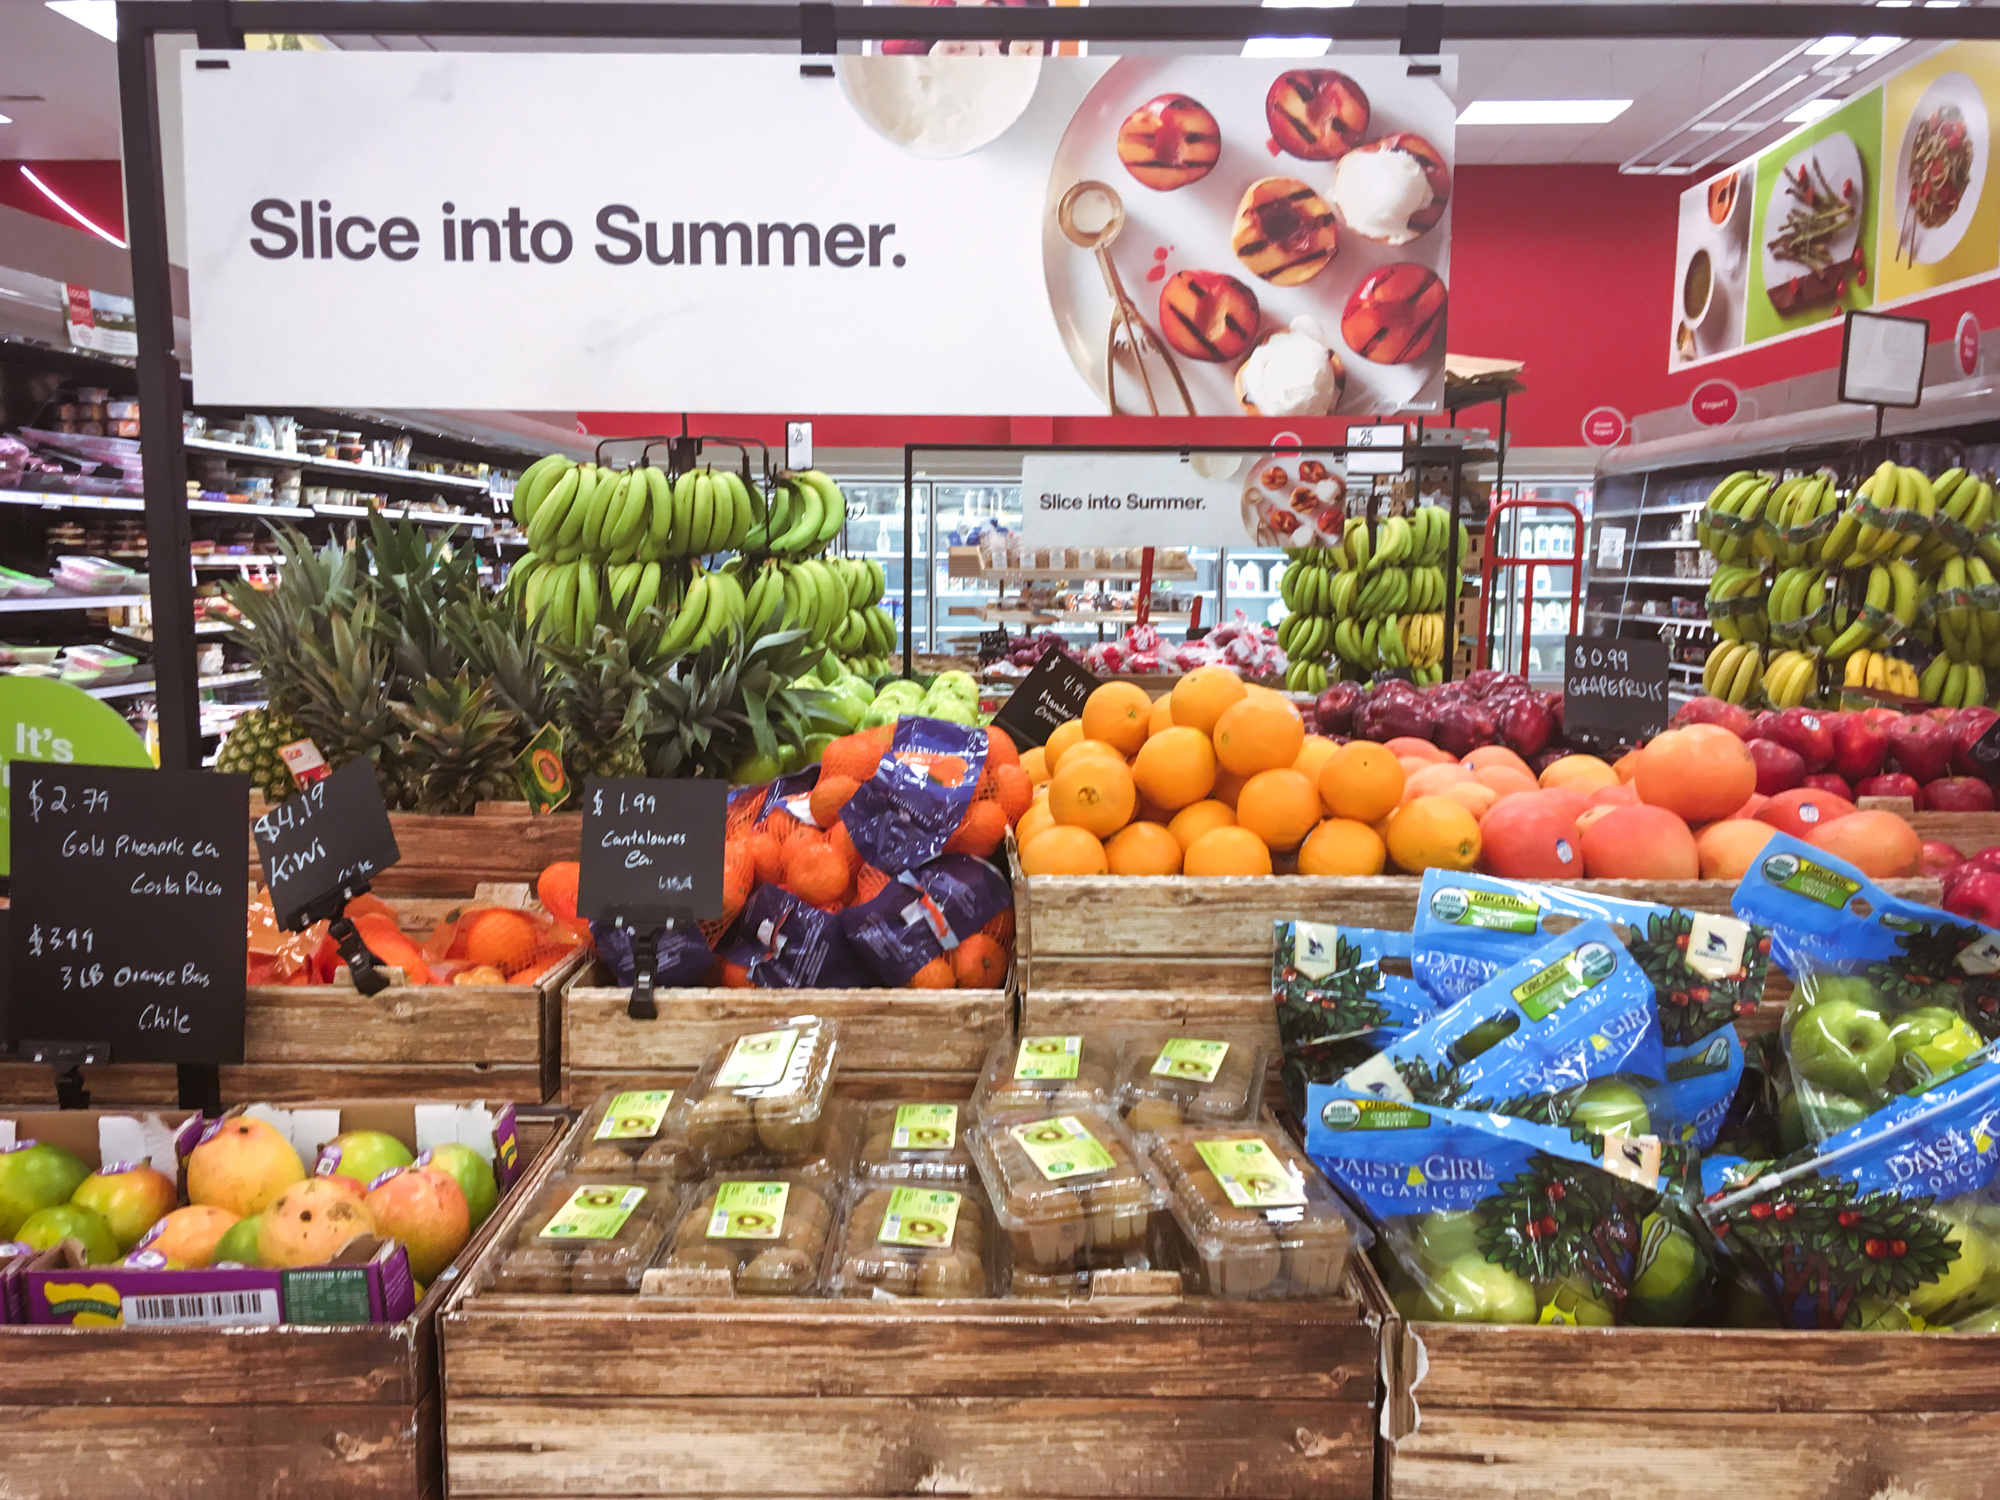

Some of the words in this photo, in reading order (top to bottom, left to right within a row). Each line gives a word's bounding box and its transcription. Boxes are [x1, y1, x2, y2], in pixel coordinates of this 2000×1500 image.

[250, 197, 421, 262] Slice
[442, 200, 574, 265] into
[594, 203, 907, 269] Summer.
[1039, 492, 1083, 511] Slice
[1087, 493, 1122, 511] into
[1126, 493, 1206, 511] Summer.
[1567, 674, 1664, 702] GRAPEFRUIT
[62, 829, 105, 858] Gold
[130, 872, 181, 896] Costa
[185, 870, 222, 896] Rica
[138, 1003, 191, 1034] Chile
